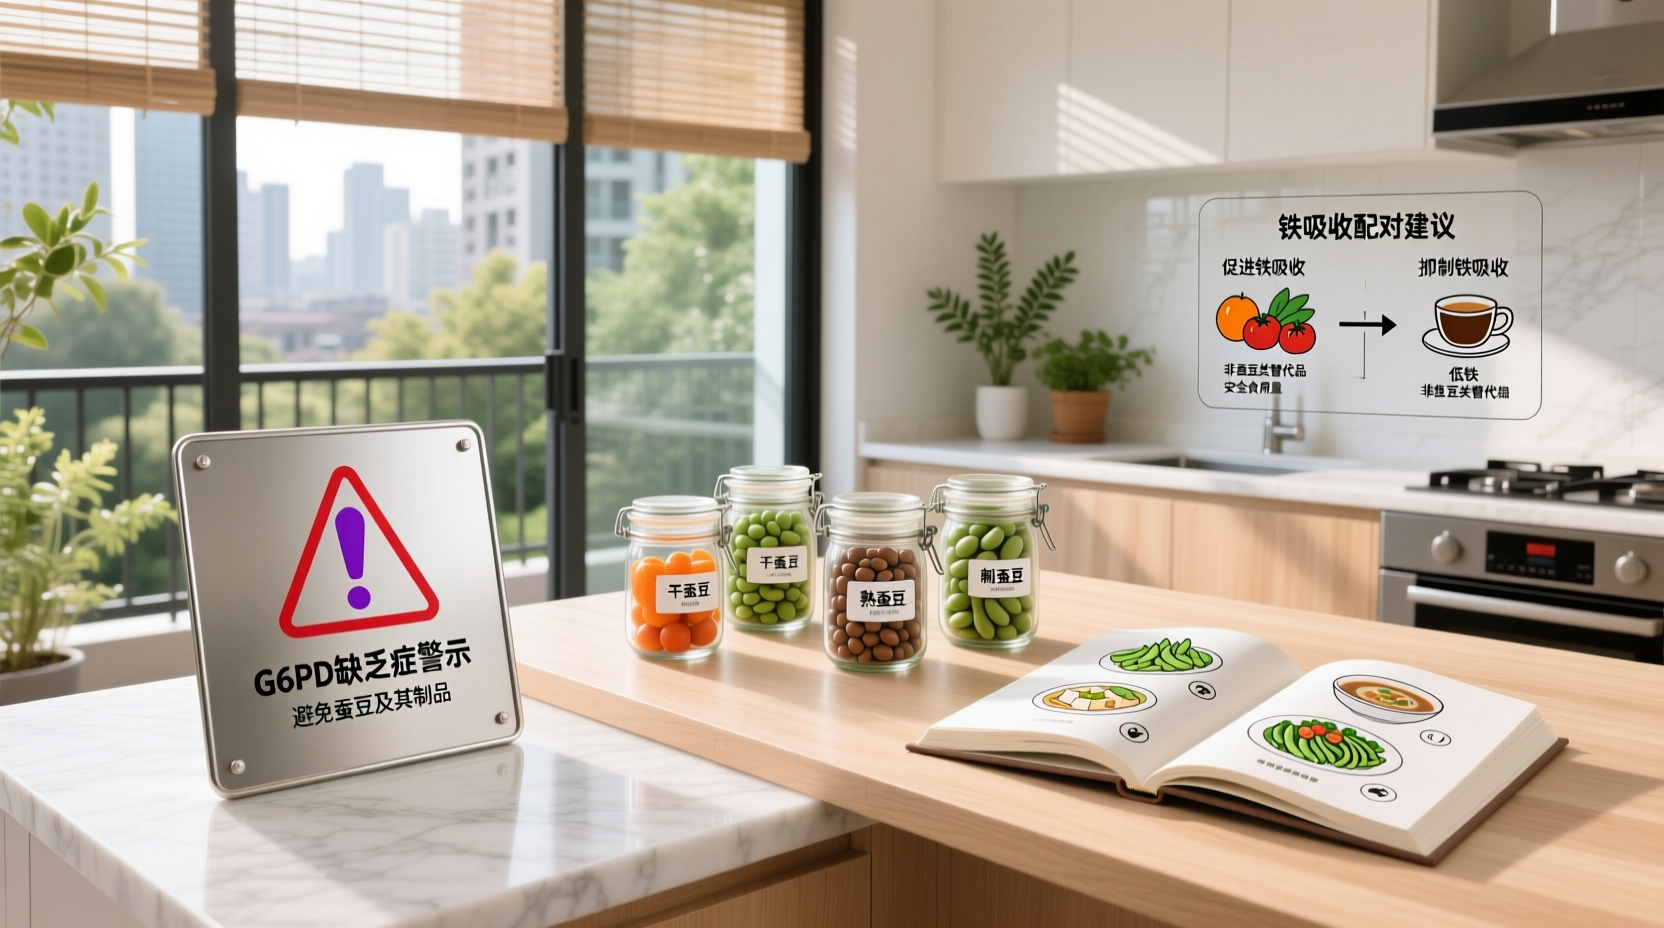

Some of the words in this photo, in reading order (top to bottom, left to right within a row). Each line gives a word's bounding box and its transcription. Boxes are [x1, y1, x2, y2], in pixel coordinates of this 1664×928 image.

[1278, 211, 1456, 241] 铁吸收配对建议
[1221, 257, 1306, 277] 促进铁吸收
[254, 638, 472, 697] G6PD缺乏症警示
[292, 682, 452, 729] 避免蚕豆及其制品
